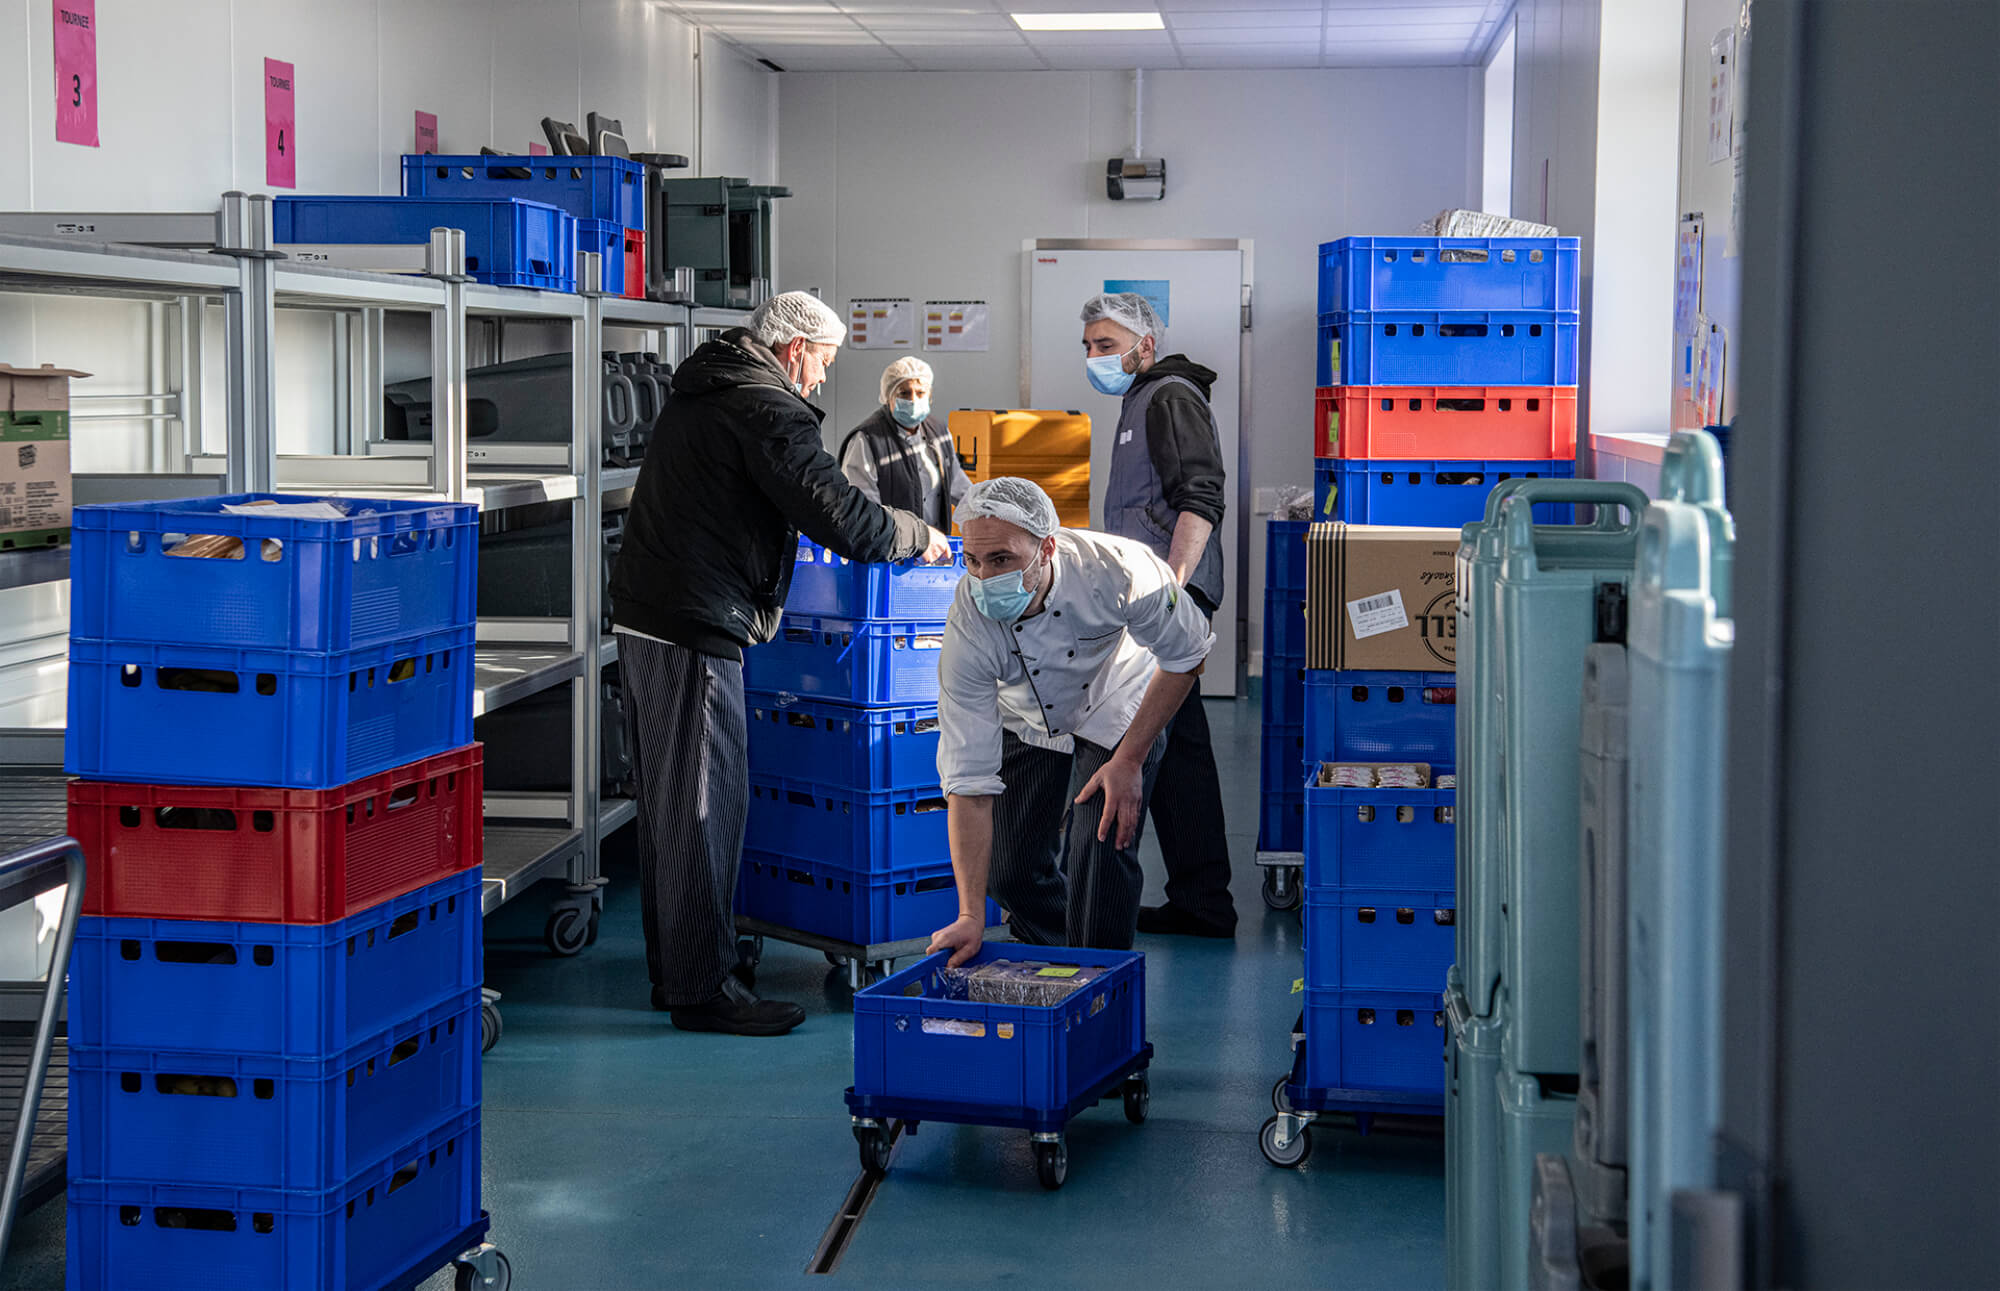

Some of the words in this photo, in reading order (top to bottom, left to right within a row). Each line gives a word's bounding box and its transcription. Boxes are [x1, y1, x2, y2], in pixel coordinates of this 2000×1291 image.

[60, 9, 89, 29] TOURNEE
[72, 74, 81, 107] 3
[278, 129, 285, 156] 4
[1420, 571, 1455, 586] Snacks
